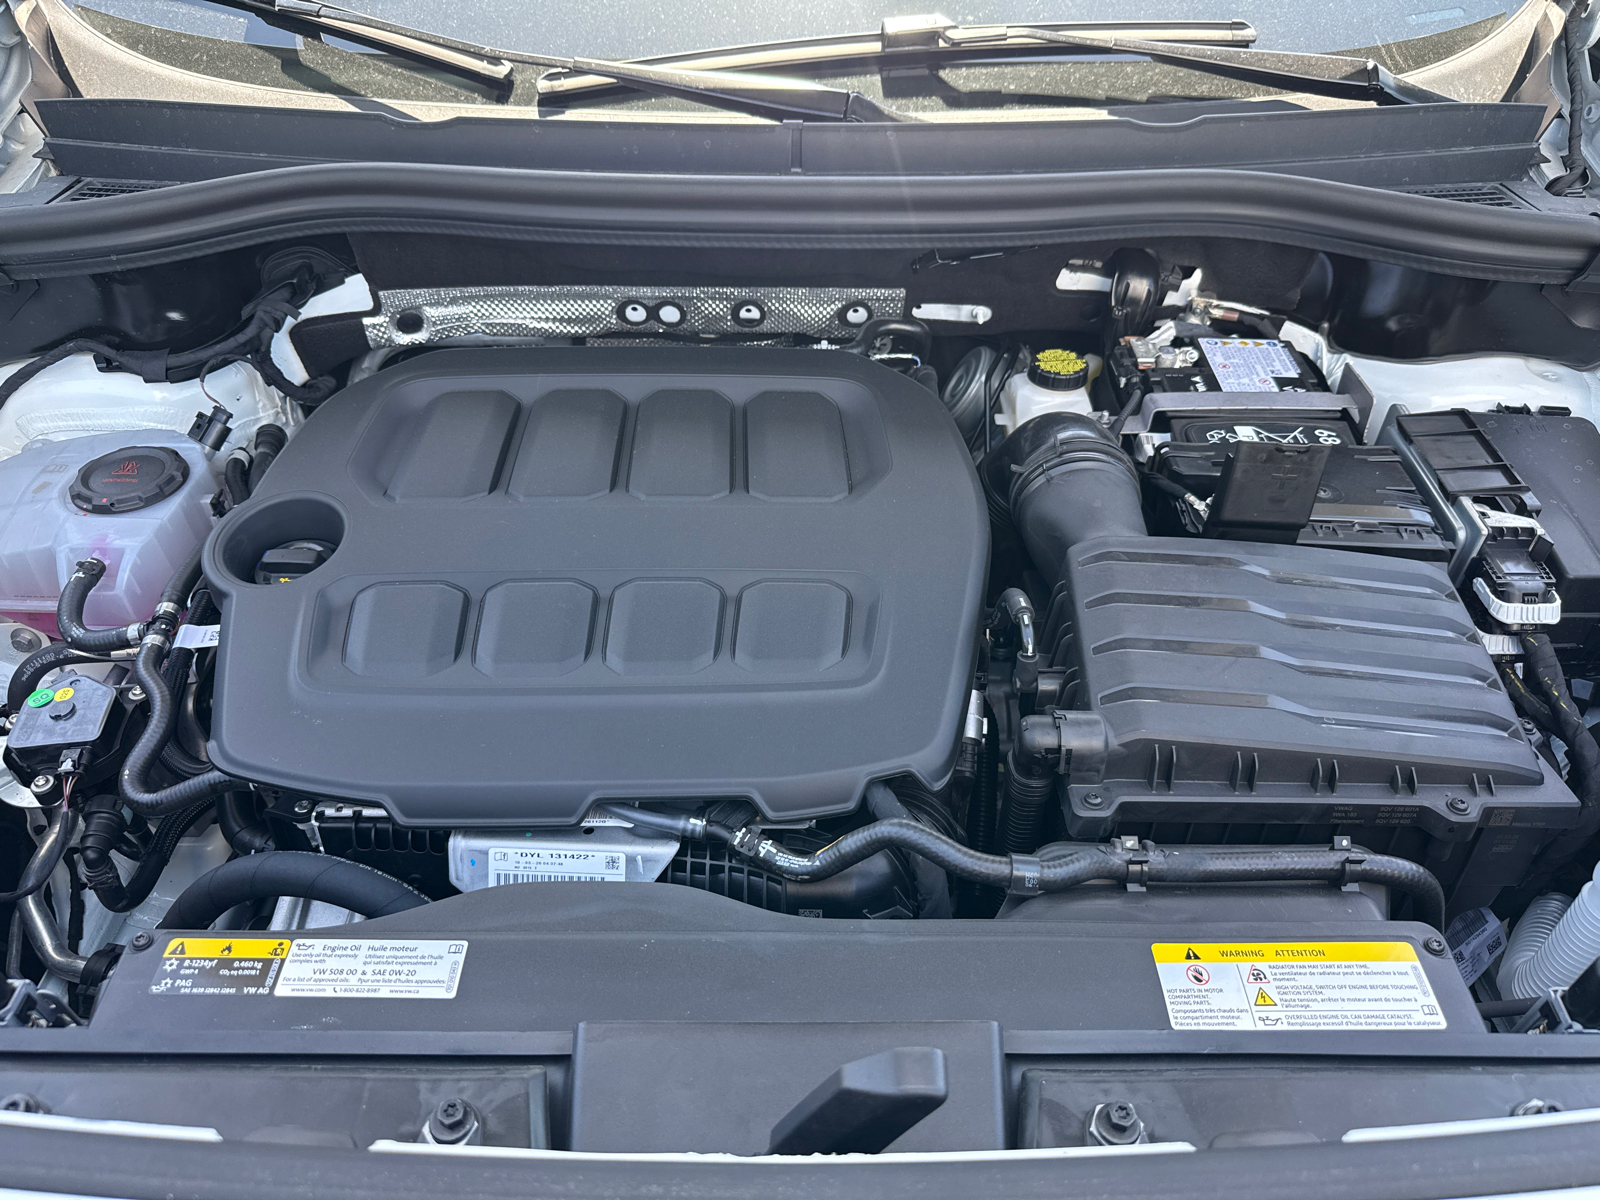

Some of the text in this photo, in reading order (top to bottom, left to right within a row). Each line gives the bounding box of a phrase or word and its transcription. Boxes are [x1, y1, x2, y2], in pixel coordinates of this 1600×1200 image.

[322, 944, 349, 952] Engine
[1219, 949, 1326, 958] WARNING ATTENTION
[183, 959, 218, 969] R-1234yf
[254, 961, 263, 969] kg
[313, 968, 328, 976] VW
[329, 968, 344, 976] 508
[345, 968, 358, 976] 00
[388, 969, 417, 977] 0W-20
[174, 979, 192, 987] PAG
